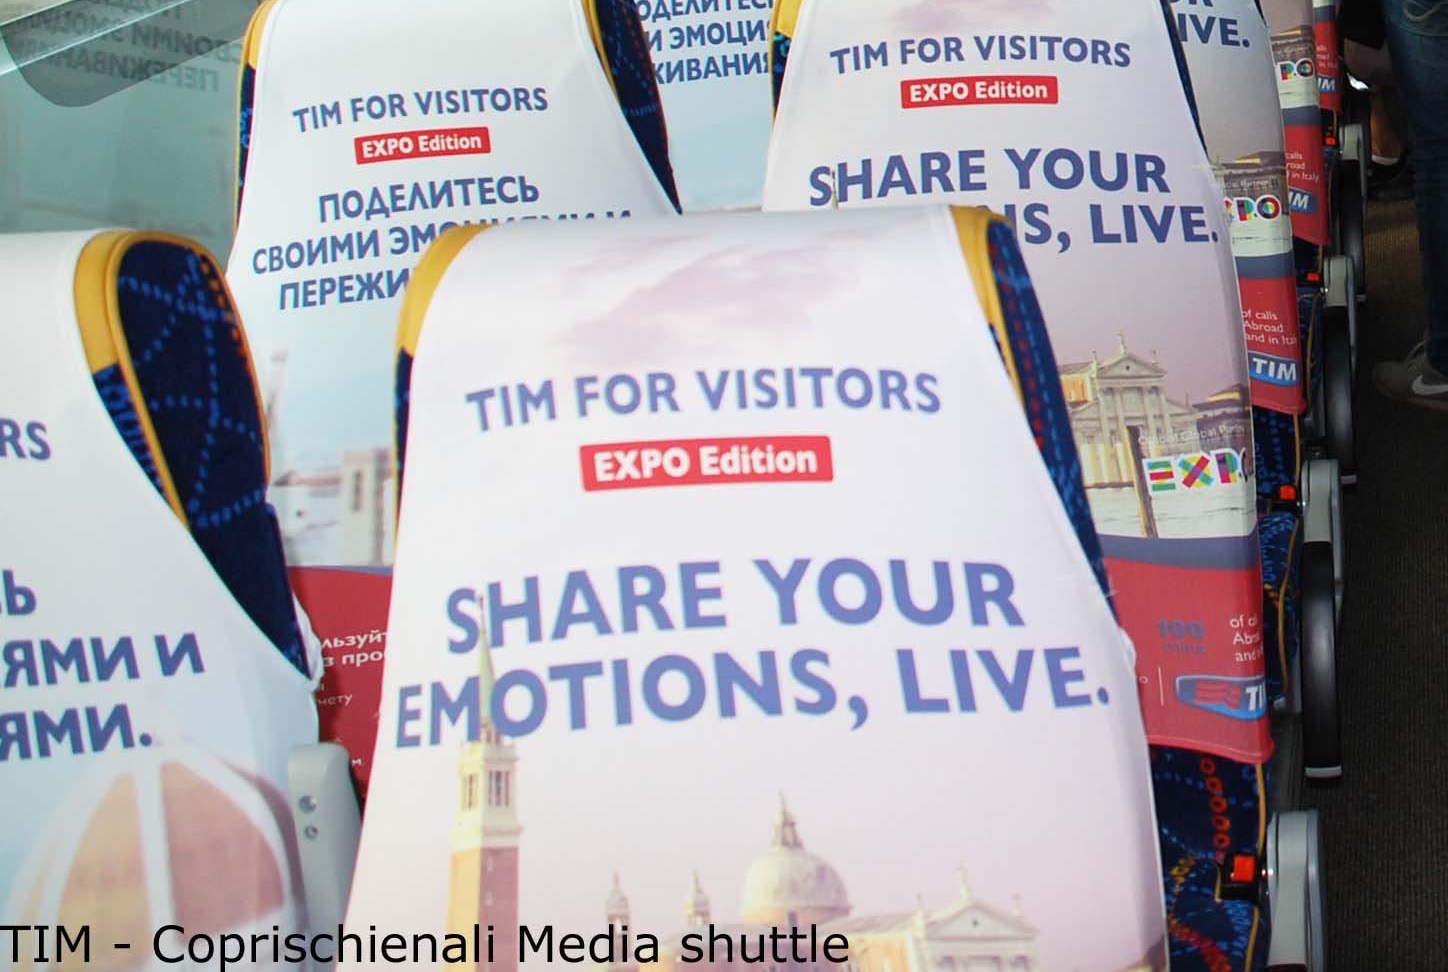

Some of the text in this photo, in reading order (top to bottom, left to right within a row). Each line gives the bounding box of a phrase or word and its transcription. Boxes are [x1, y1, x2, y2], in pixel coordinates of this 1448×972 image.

[669, 19, 771, 50] ЭМОЦИ
[1177, 13, 1250, 48] IVE.
[829, 34, 1131, 75] TIM FOR VISITORS
[292, 87, 548, 133] TIM FOR VISITORS
[909, 80, 1048, 103] EXPO Edition
[361, 133, 482, 159] EXPO Edition
[810, 148, 1171, 206] SHARE YOUR
[318, 175, 539, 224] ПОДЕЛИТЕСЬ
[1289, 191, 1309, 209] IM
[1091, 206, 1219, 245] LIVE.
[252, 229, 380, 276] СВОИМИ
[279, 268, 411, 310] ПЕРЕЖИ
[1243, 321, 1284, 333] Abroad
[1255, 311, 1278, 321] calls
[1268, 335, 1279, 344] in
[1252, 357, 1297, 382] TIM
[465, 367, 942, 432] TIM FOR VISITORS
[593, 445, 818, 483] EXPO Edition
[445, 558, 1024, 654] SHARE YOUR
[1230, 615, 1244, 628] of
[154, 632, 206, 678] И
[395, 645, 1110, 749] EMOTIONS, LIVE.
